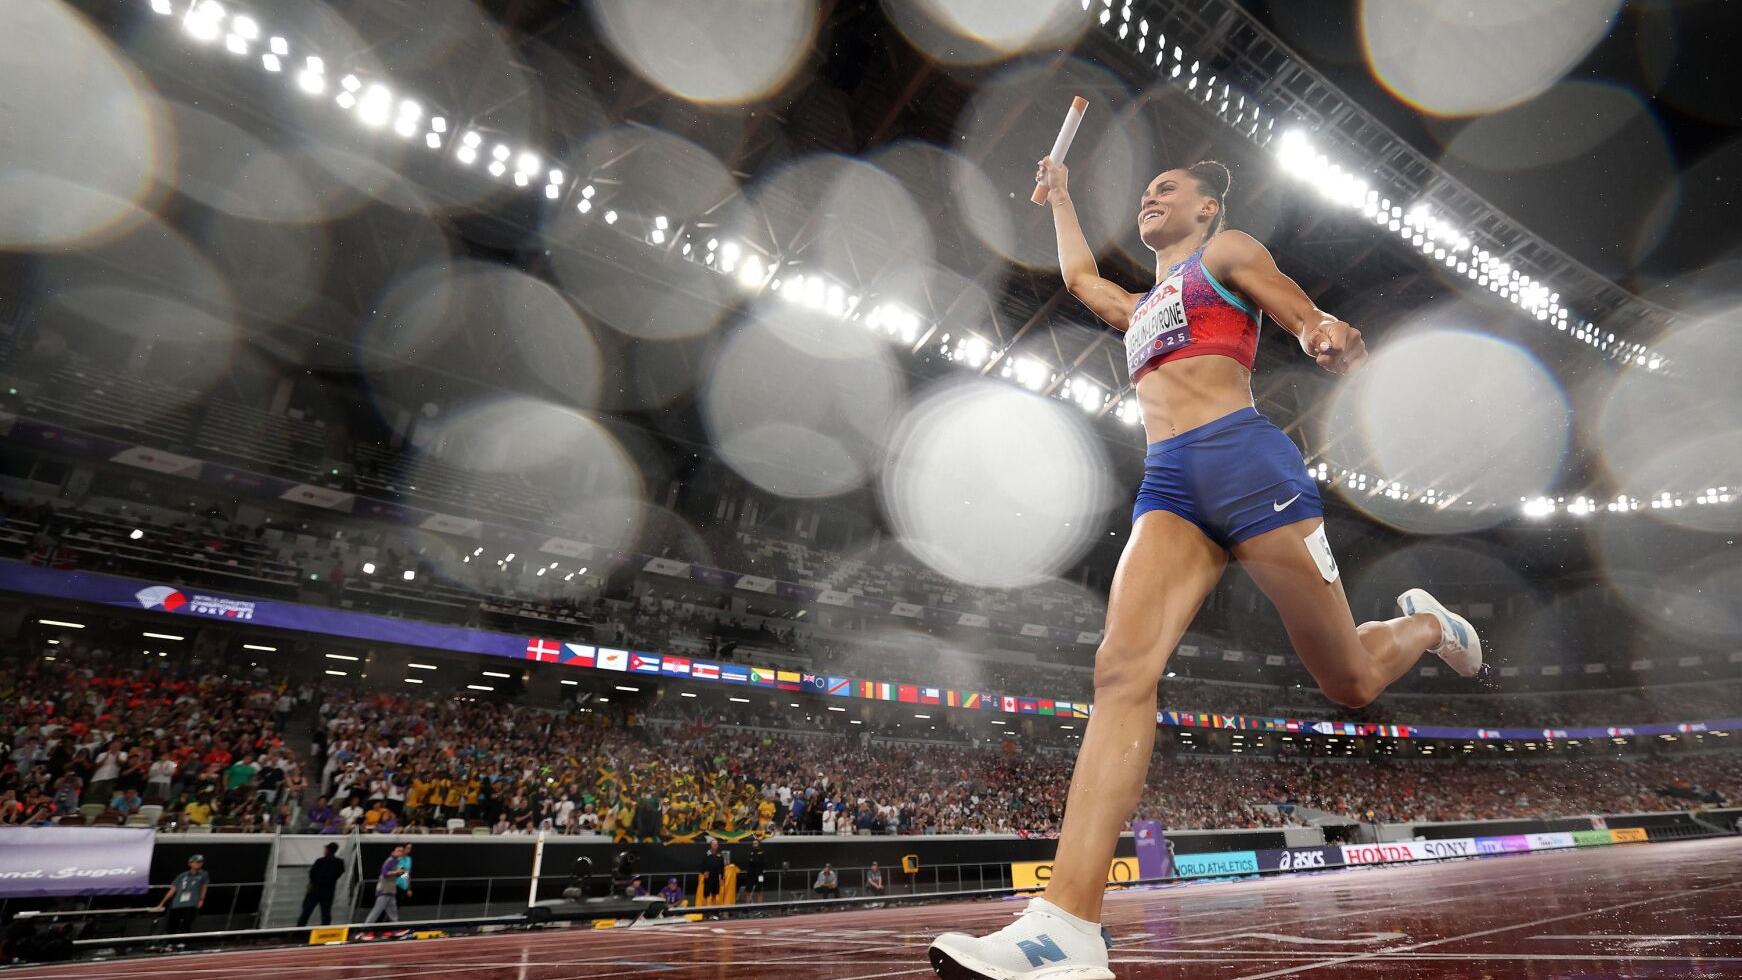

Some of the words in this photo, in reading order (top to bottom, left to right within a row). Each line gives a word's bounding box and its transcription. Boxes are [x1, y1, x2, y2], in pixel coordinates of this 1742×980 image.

[1346, 846, 1413, 864] HONDA
[1424, 841, 1467, 858] SONY
[1207, 859, 1254, 873] ATHLETICS
[1016, 933, 1068, 968] N
